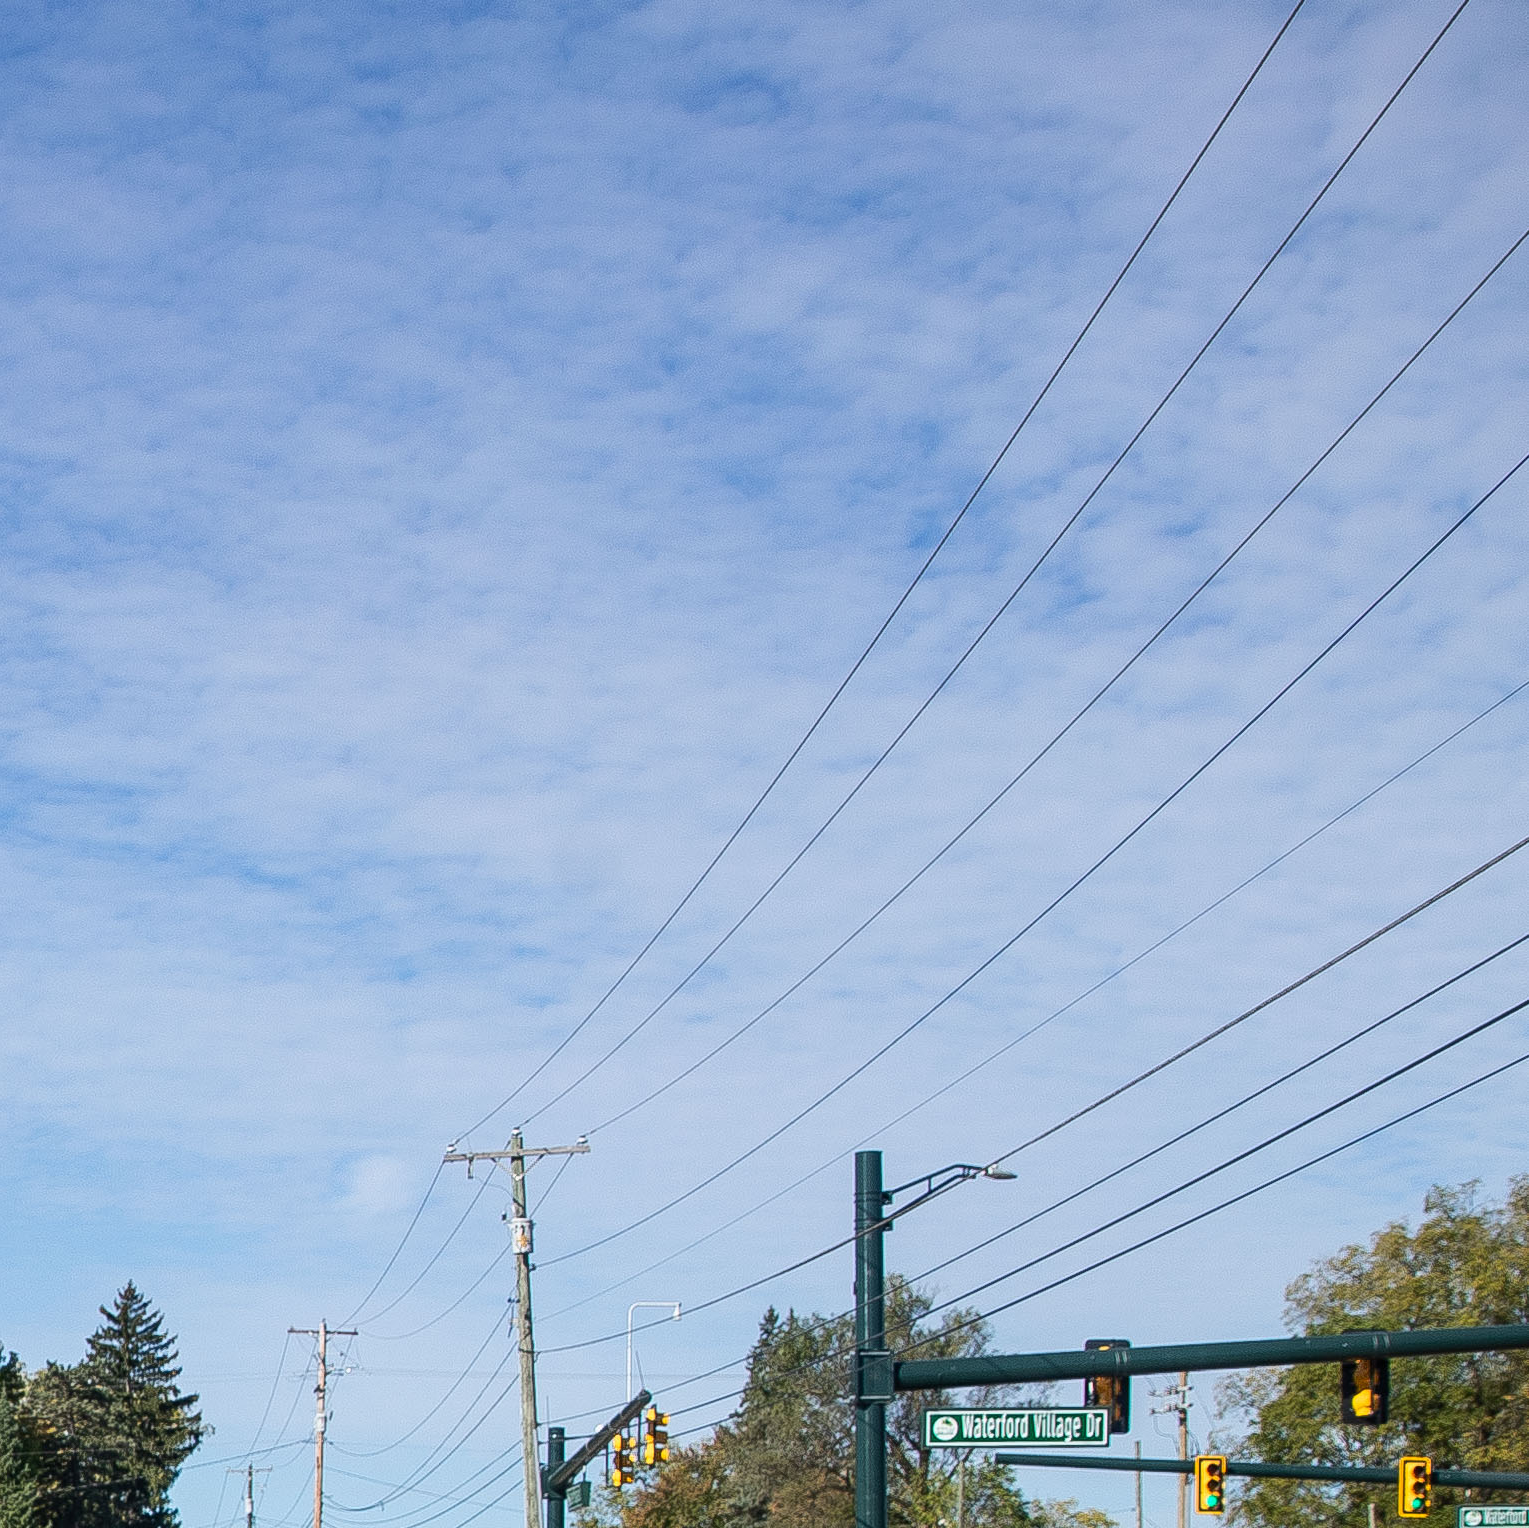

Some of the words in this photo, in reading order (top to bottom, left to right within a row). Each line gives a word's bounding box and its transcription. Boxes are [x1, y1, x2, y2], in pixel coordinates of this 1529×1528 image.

[961, 1413, 1029, 1439] Waterford
[1033, 1413, 1082, 1443] Village
[1086, 1413, 1102, 1438] Dr
